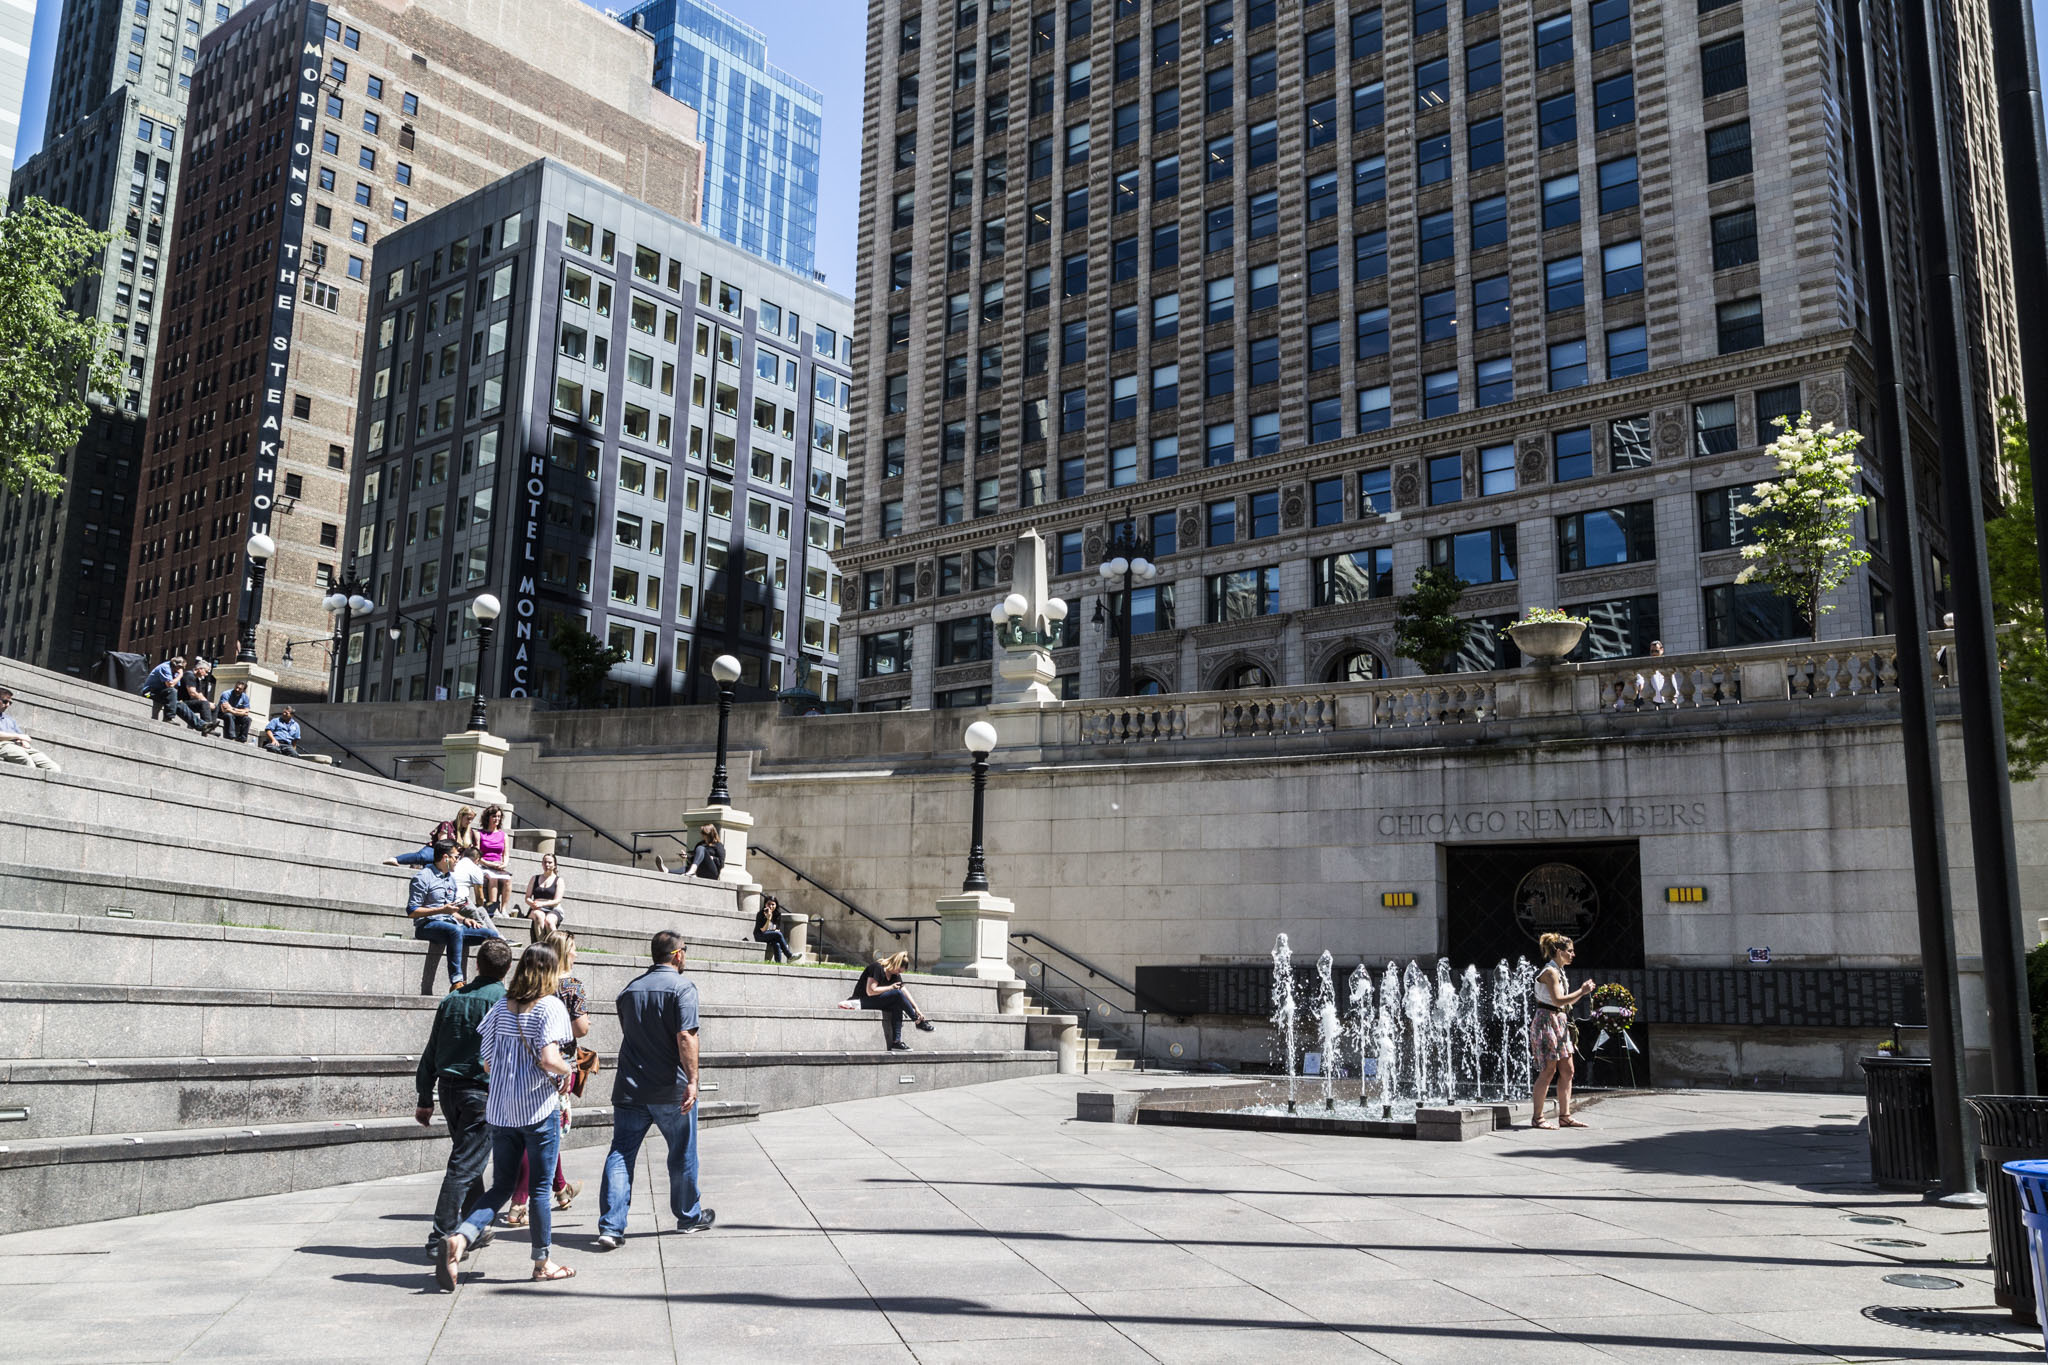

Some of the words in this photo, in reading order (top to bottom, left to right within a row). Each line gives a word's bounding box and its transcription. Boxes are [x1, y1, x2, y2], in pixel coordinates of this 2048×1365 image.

[290, 41, 322, 207] MORTONS
[278, 244, 298, 310] THE
[246, 335, 288, 592] STEAKHOU
[525, 455, 544, 561] HOTEL
[511, 575, 535, 698] MONACO
[1377, 810, 1506, 838] CHICAGO
[1515, 802, 1706, 833] REMEMBERS
